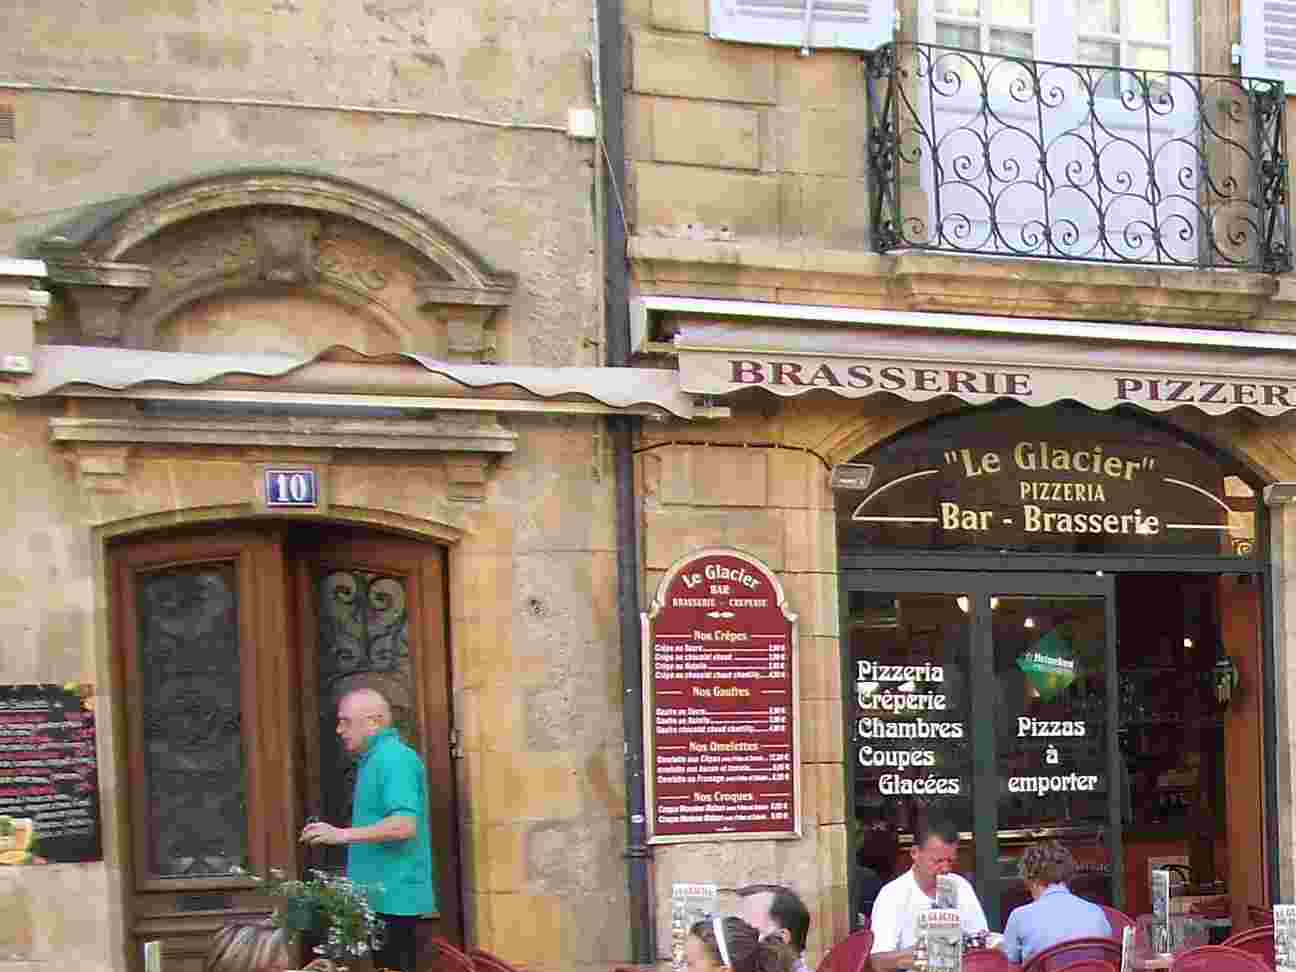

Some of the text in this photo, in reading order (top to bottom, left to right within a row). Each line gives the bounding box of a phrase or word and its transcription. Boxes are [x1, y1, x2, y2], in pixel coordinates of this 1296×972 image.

[727, 358, 1033, 397] BRASSERIE
[278, 474, 306, 502] 10
[1020, 481, 1105, 503] PIZZERIA
[939, 502, 993, 531] Bar
[1023, 504, 1160, 536] Brasserie
[682, 563, 762, 589] Le Glacier
[709, 585, 731, 595] BAR
[693, 631, 712, 641] Nos
[856, 660, 944, 682] Pizzeria
[857, 688, 946, 714] Crêperie
[858, 717, 964, 739] Chambres
[1016, 716, 1086, 738] Pizzas
[858, 745, 936, 771] Coupes
[1045, 744, 1059, 764] à
[879, 773, 960, 795] Glacées
[1008, 773, 1098, 796] emporter
